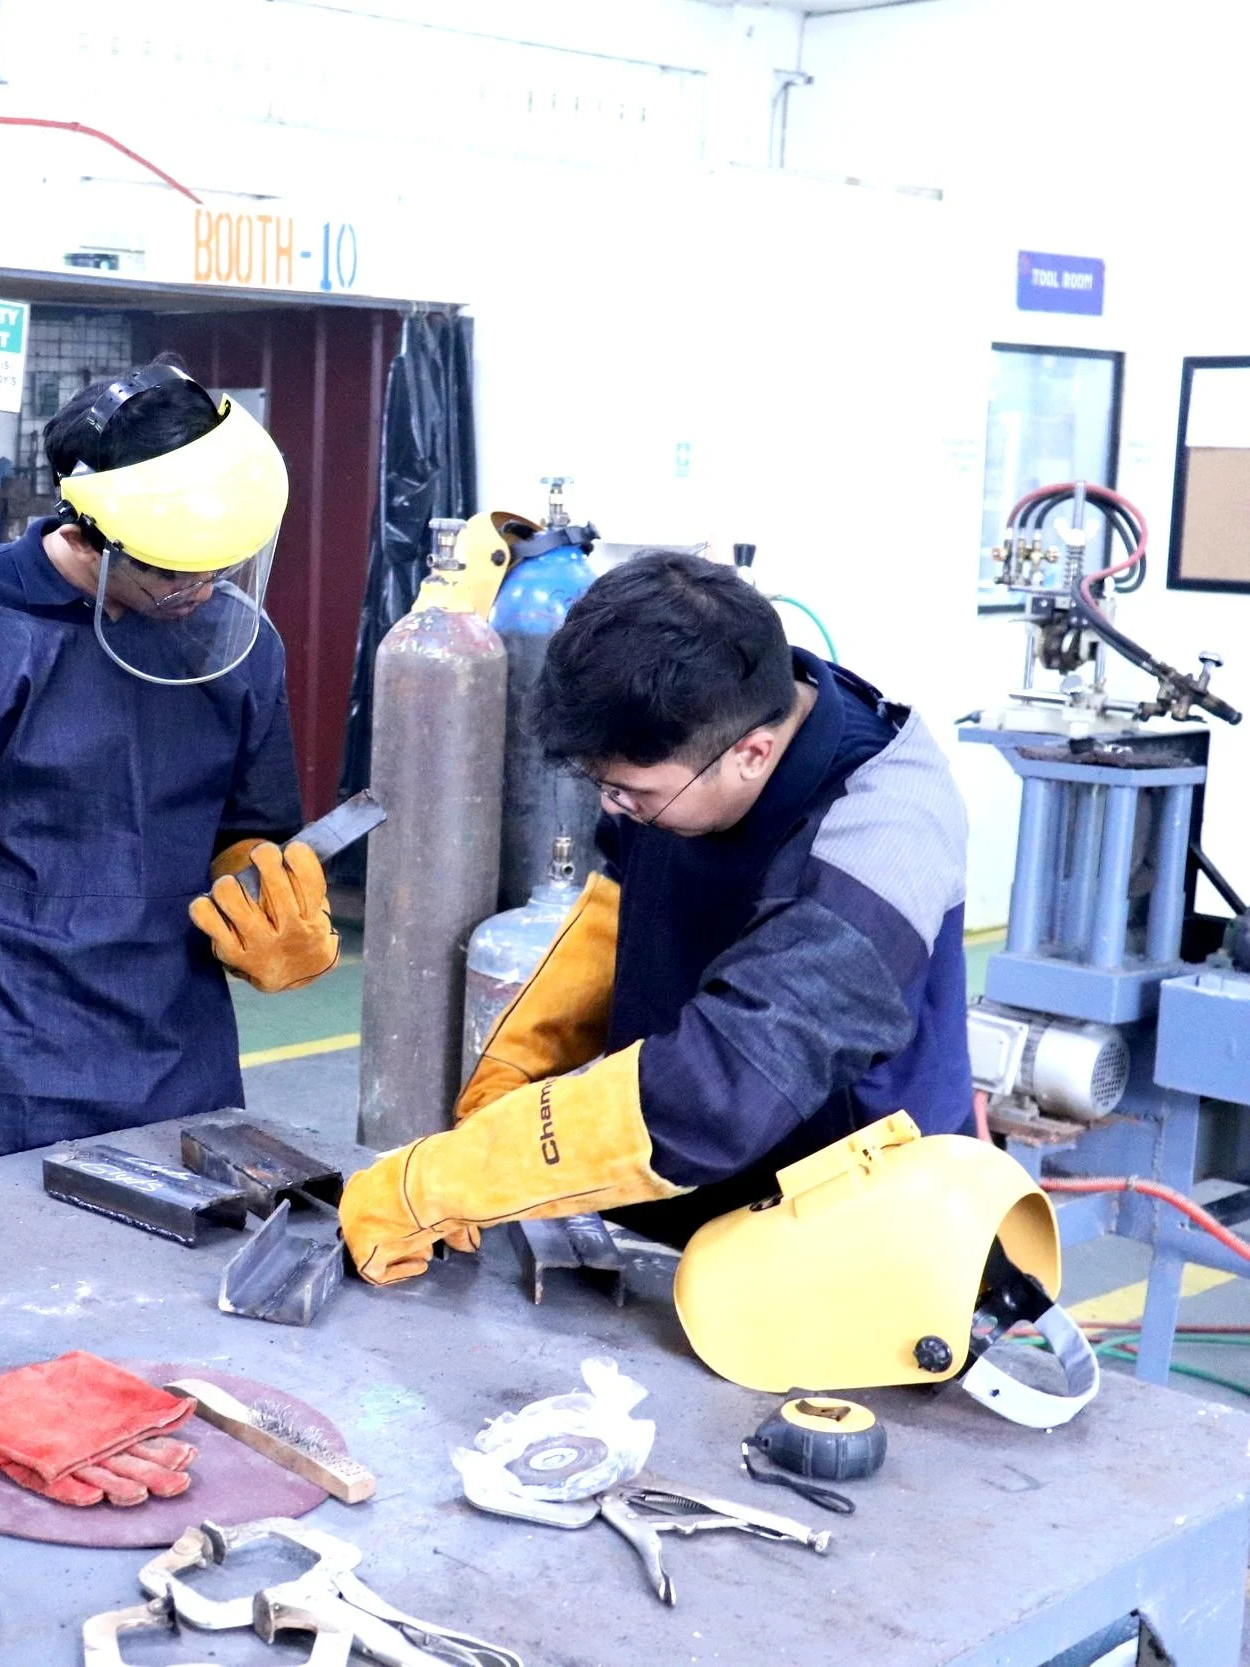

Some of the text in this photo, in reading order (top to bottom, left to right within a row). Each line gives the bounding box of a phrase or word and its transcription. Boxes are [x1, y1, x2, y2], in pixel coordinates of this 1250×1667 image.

[1032, 267, 1093, 290] TOOL ROOM
[540, 1079, 561, 1166] Cham
